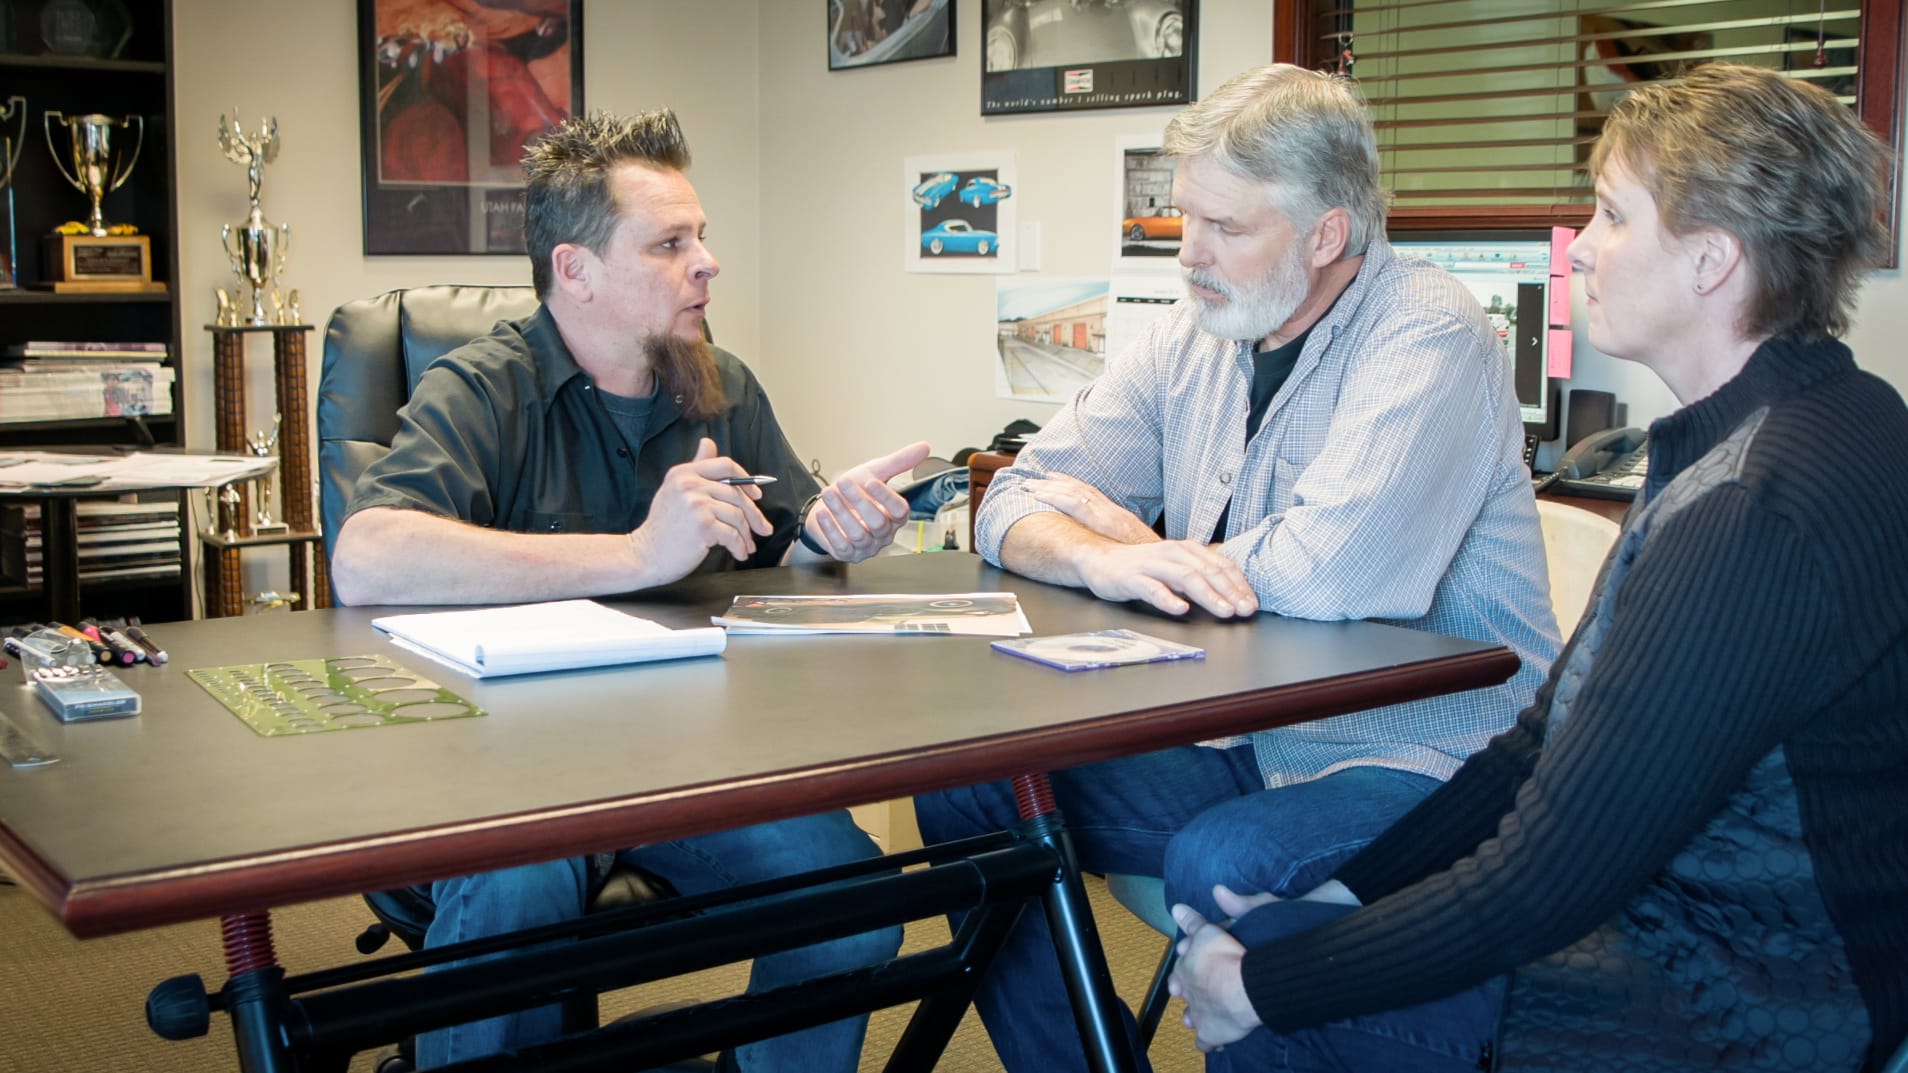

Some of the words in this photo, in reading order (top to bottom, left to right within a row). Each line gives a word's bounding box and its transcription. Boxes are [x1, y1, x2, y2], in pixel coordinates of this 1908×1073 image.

[986, 100, 1000, 109] The
[1004, 97, 1036, 107] world's
[1040, 95, 1073, 105] number
[1086, 92, 1120, 103] selling
[1124, 90, 1152, 102] spark
[481, 201, 510, 213] UTAH
